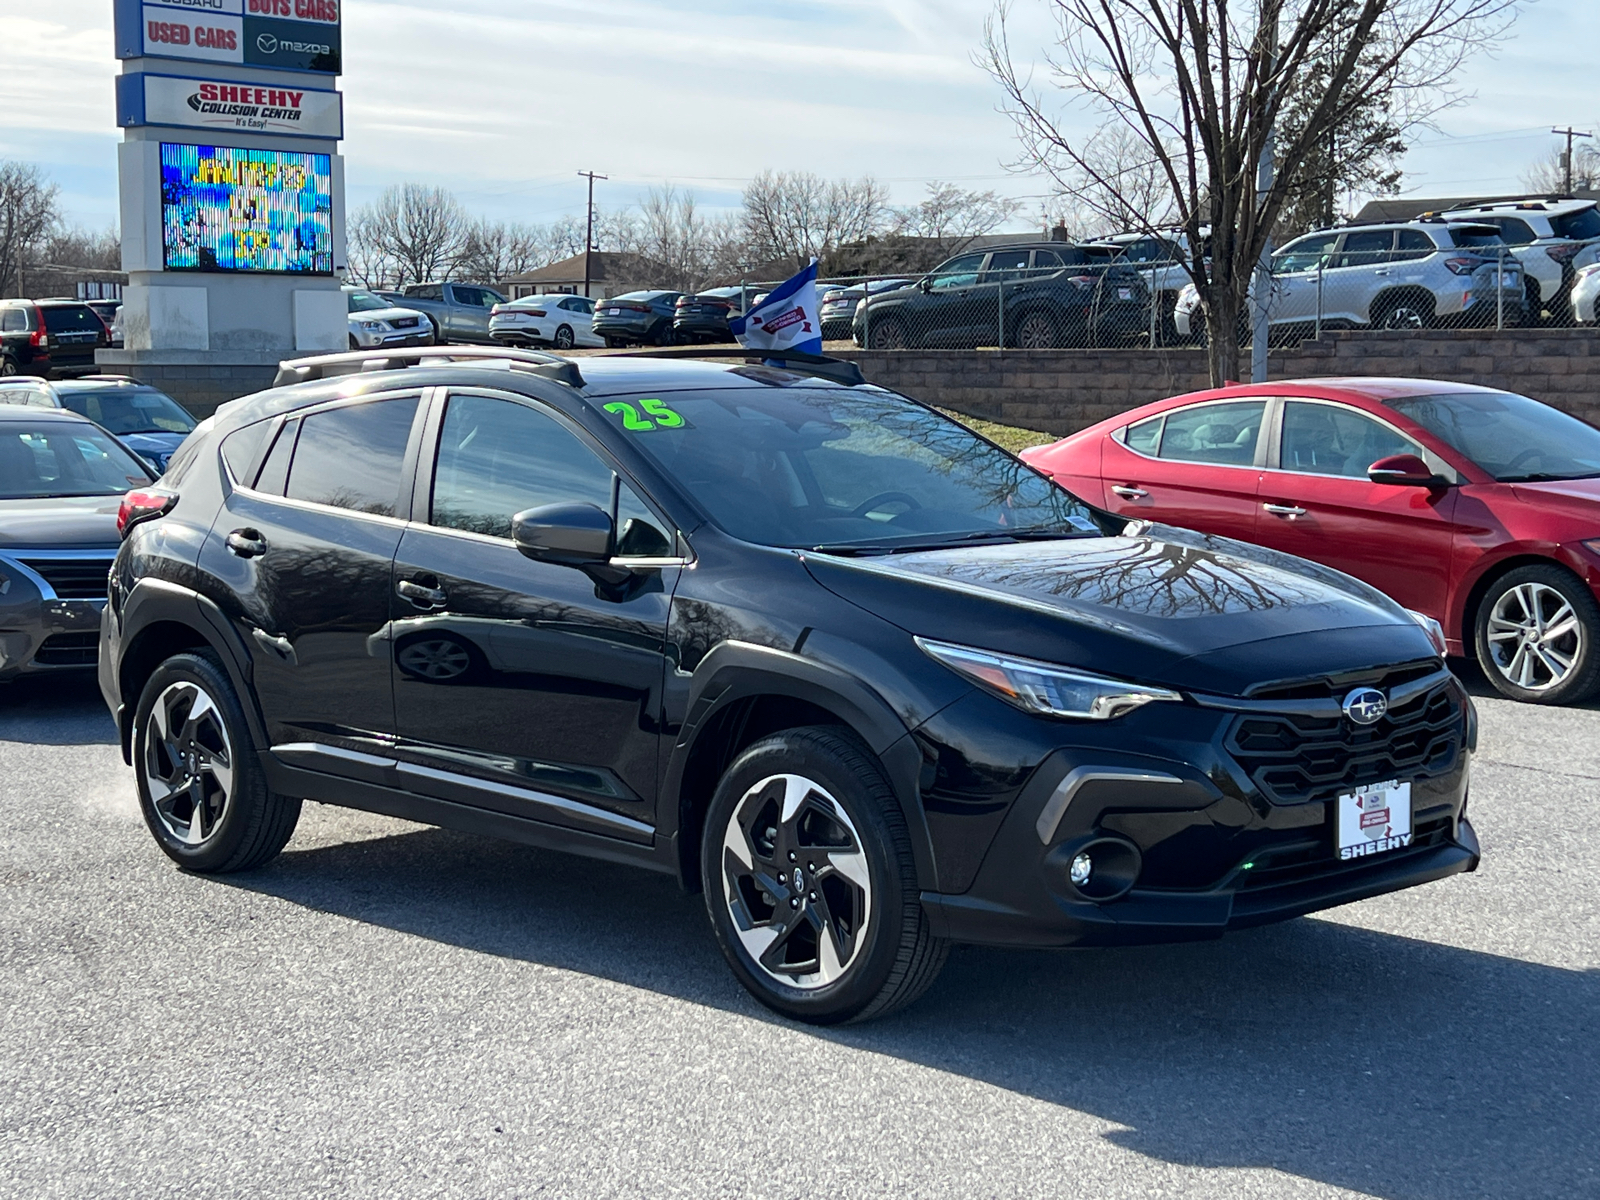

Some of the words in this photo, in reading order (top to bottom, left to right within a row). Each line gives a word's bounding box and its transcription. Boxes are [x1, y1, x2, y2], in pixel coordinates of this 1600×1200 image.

[249, 0, 290, 16] BUYS
[295, 0, 337, 22] CARS
[148, 20, 190, 45] USED
[194, 26, 237, 50] CARS
[280, 40, 330, 55] mazda
[200, 84, 304, 108] SHEEHY
[201, 102, 259, 117] COLLISION
[260, 107, 302, 121] CENTER
[236, 117, 246, 127] It's
[248, 118, 267, 130] Easy!
[603, 398, 686, 432] 25
[1341, 833, 1412, 860] SHEEHY
